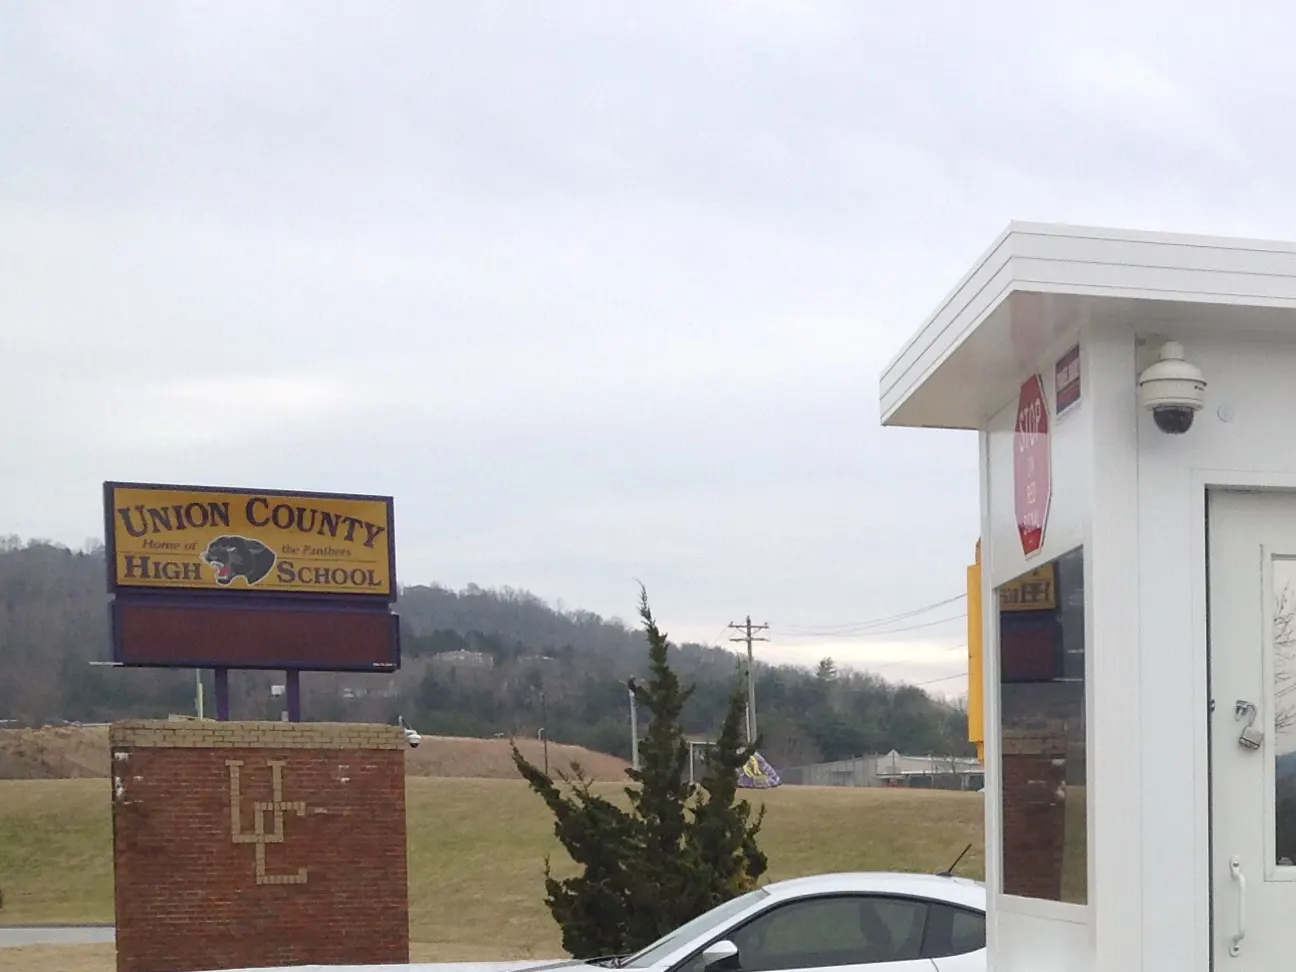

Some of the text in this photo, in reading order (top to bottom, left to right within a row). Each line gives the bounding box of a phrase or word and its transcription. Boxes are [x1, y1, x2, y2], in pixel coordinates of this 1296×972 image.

[1019, 397, 1041, 452] STOP
[117, 497, 386, 549] UNION COUNTY
[142, 538, 351, 557] Home of the Panthers
[123, 555, 382, 586] HIGH SCHOOL
